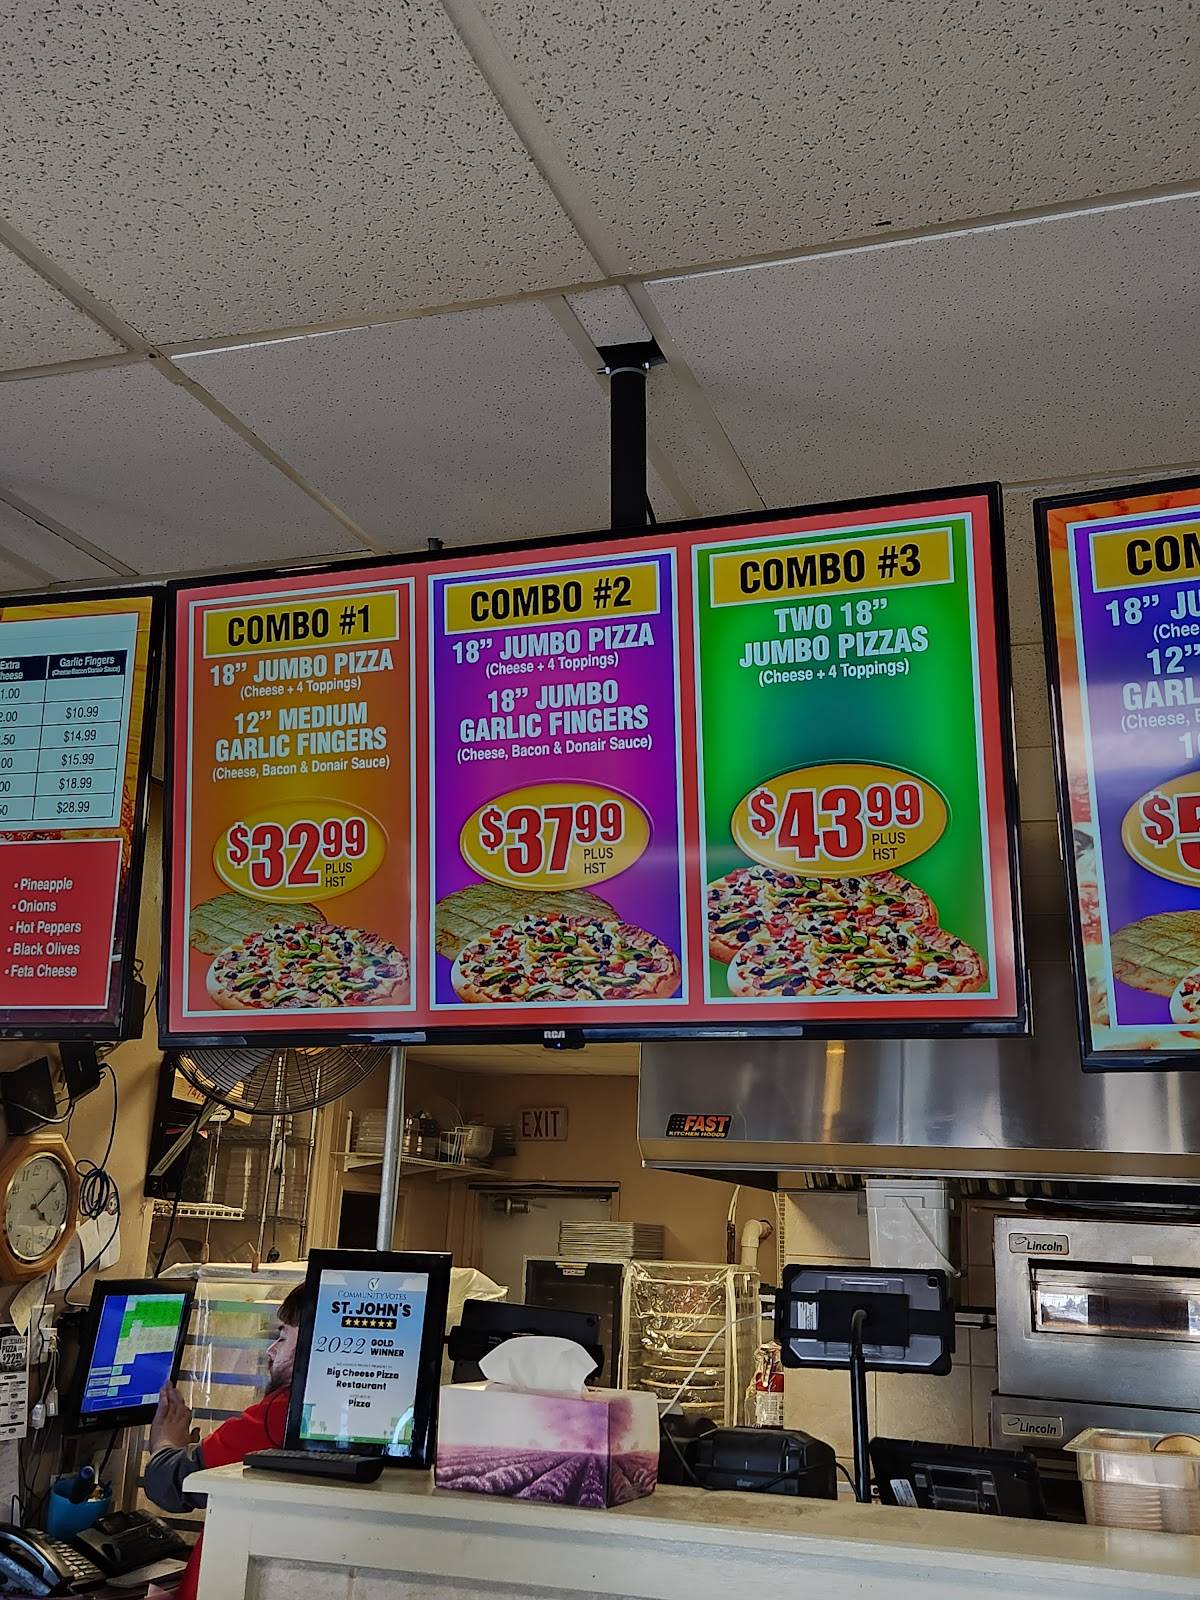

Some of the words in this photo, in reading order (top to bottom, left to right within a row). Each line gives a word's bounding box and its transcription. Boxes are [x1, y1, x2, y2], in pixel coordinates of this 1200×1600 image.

[740, 549, 865, 594] COMBO
[878, 543, 921, 579] #3
[471, 581, 582, 622] COMBO
[593, 576, 632, 609] #2
[228, 609, 329, 646] COMBO
[339, 604, 369, 635] #1
[774, 605, 831, 633] TWO
[500, 630, 580, 660] JUMBO
[588, 622, 654, 651] PIZZA
[739, 635, 829, 668] JUMBO
[838, 626, 929, 659] PIZZAS
[60, 657, 83, 667] Garlic
[84, 656, 115, 666] Fingers
[253, 654, 327, 683] JUMBO
[334, 648, 394, 675] PIZZA
[485, 662, 534, 679] (Cheese
[537, 663, 544, 671] +
[547, 658, 554, 670] 4
[558, 652, 619, 671] Toppings)
[758, 669, 813, 687] (Cheese
[817, 671, 825, 679] +
[828, 665, 837, 678] 4
[840, 658, 910, 680] Toppings)
[240, 684, 284, 700] (Cheese
[296, 682, 303, 692] 4
[306, 676, 362, 694] Toppings)
[535, 679, 618, 710] JUMBO
[66, 706, 99, 720] $10.99
[278, 702, 367, 731] MEDIUM
[460, 714, 542, 743] GARLIC
[549, 705, 649, 736] FINGERS
[1121, 713, 1190, 733] (Cheese,
[64, 730, 97, 743] $14.99
[216, 734, 290, 762] GARLIC
[297, 727, 387, 757] FINGERS
[457, 746, 508, 764] (Cheese,
[512, 743, 550, 757] Bacon
[553, 742, 562, 754] &
[566, 738, 606, 753] Donair
[610, 734, 653, 750] Sauce)
[61, 754, 94, 766] $15.99
[212, 766, 259, 783] (Cheese,
[263, 764, 296, 777] Bacon
[300, 761, 308, 773] &
[312, 759, 348, 772] Donair
[351, 755, 390, 770] Sauce)
[59, 777, 92, 790] $18.99
[56, 801, 90, 814] $28.99
[872, 832, 906, 845] PLUS
[584, 848, 614, 860] PLUS
[873, 848, 898, 861] HST
[325, 862, 352, 874] PLUS
[584, 863, 606, 874] HST
[20, 877, 73, 893] Pineapple
[325, 876, 346, 888] HST
[17, 899, 57, 912] Onions
[15, 921, 35, 934] Hot
[37, 921, 81, 936] Peppers
[13, 943, 43, 955] Black
[46, 942, 80, 955] Olives
[10, 965, 34, 977] Feta
[37, 964, 77, 977] Cheese
[544, 1030, 565, 1038] RCA
[522, 1110, 560, 1137] EXIT
[684, 1116, 730, 1132] FAST
[1026, 1240, 1062, 1252] Lincoln
[331, 1301, 353, 1314] ST.
[356, 1302, 411, 1317] JOHN'S
[315, 1336, 366, 1354] 2022
[371, 1339, 394, 1347] GOLD
[370, 1348, 404, 1357] WINNER
[327, 1367, 341, 1378] Big
[342, 1369, 375, 1378] Cheese
[376, 1370, 399, 1379] Pizza
[336, 1380, 387, 1390] Restaurant
[348, 1399, 371, 1408] Pizza
[1020, 1422, 1056, 1434] Lincoln
